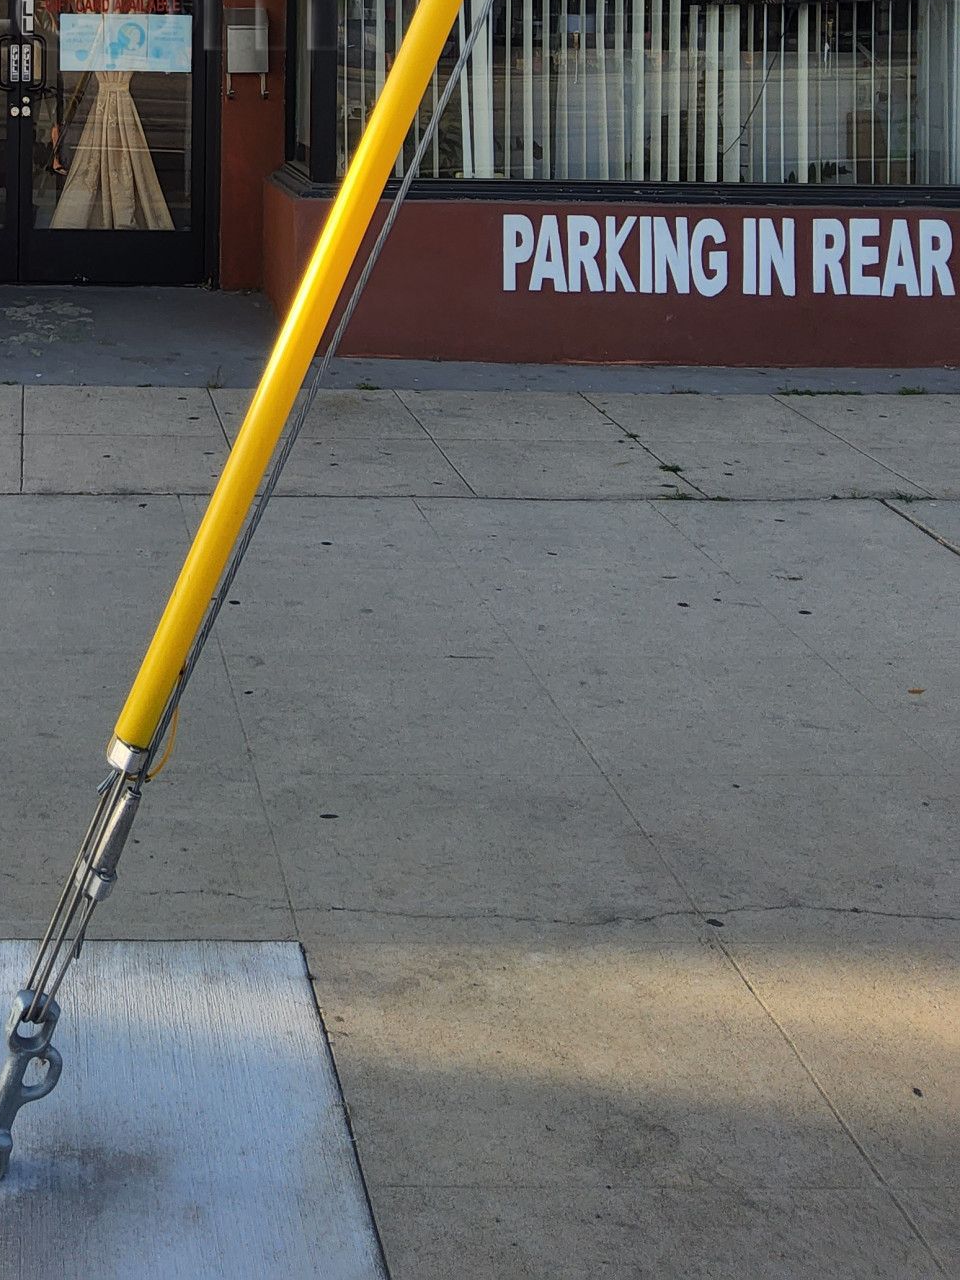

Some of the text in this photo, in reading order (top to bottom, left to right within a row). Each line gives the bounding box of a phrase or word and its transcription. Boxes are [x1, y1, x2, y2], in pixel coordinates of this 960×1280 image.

[502, 213, 956, 298] PARKING IN REAR
